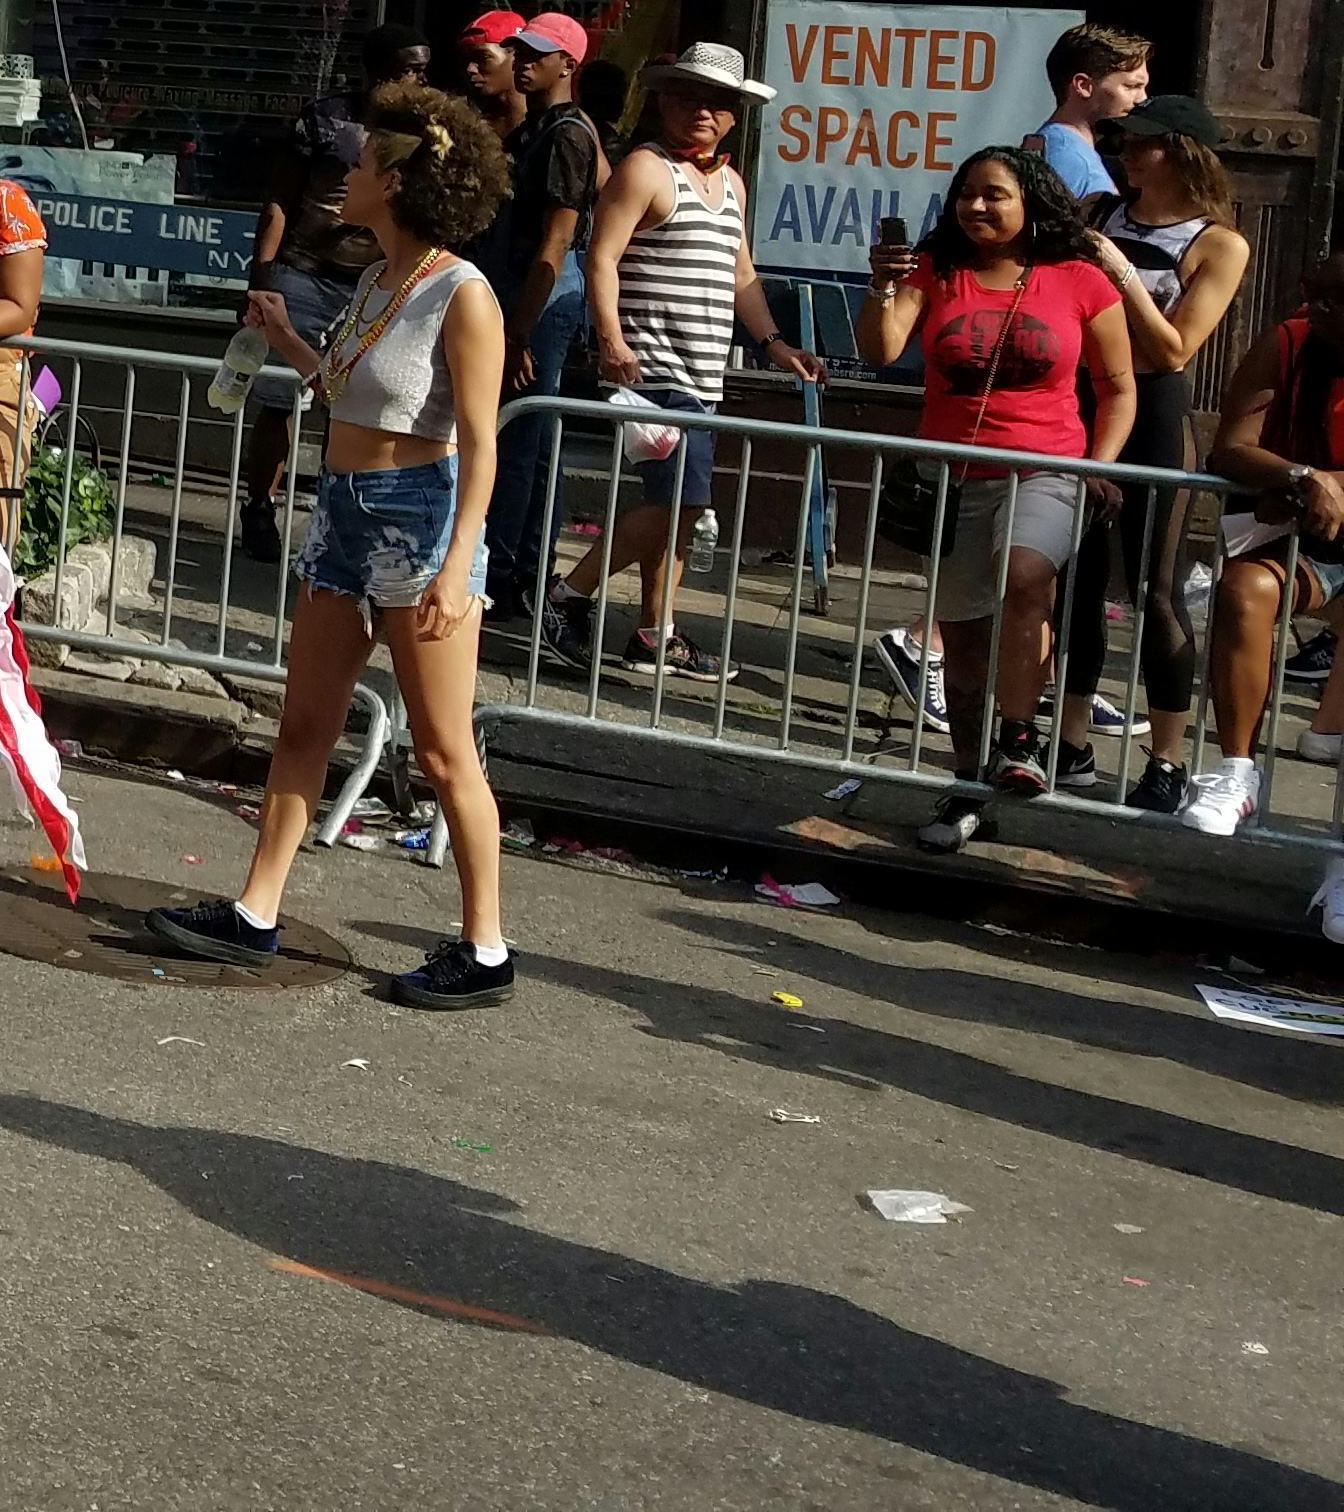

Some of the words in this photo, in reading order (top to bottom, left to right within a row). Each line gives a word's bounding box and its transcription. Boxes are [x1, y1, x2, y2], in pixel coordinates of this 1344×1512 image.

[786, 24, 997, 91] VENTED
[777, 105, 958, 171] SPACE
[38, 200, 134, 234] POLICE
[159, 213, 223, 245] LINE
[769, 184, 944, 246] AVAIA
